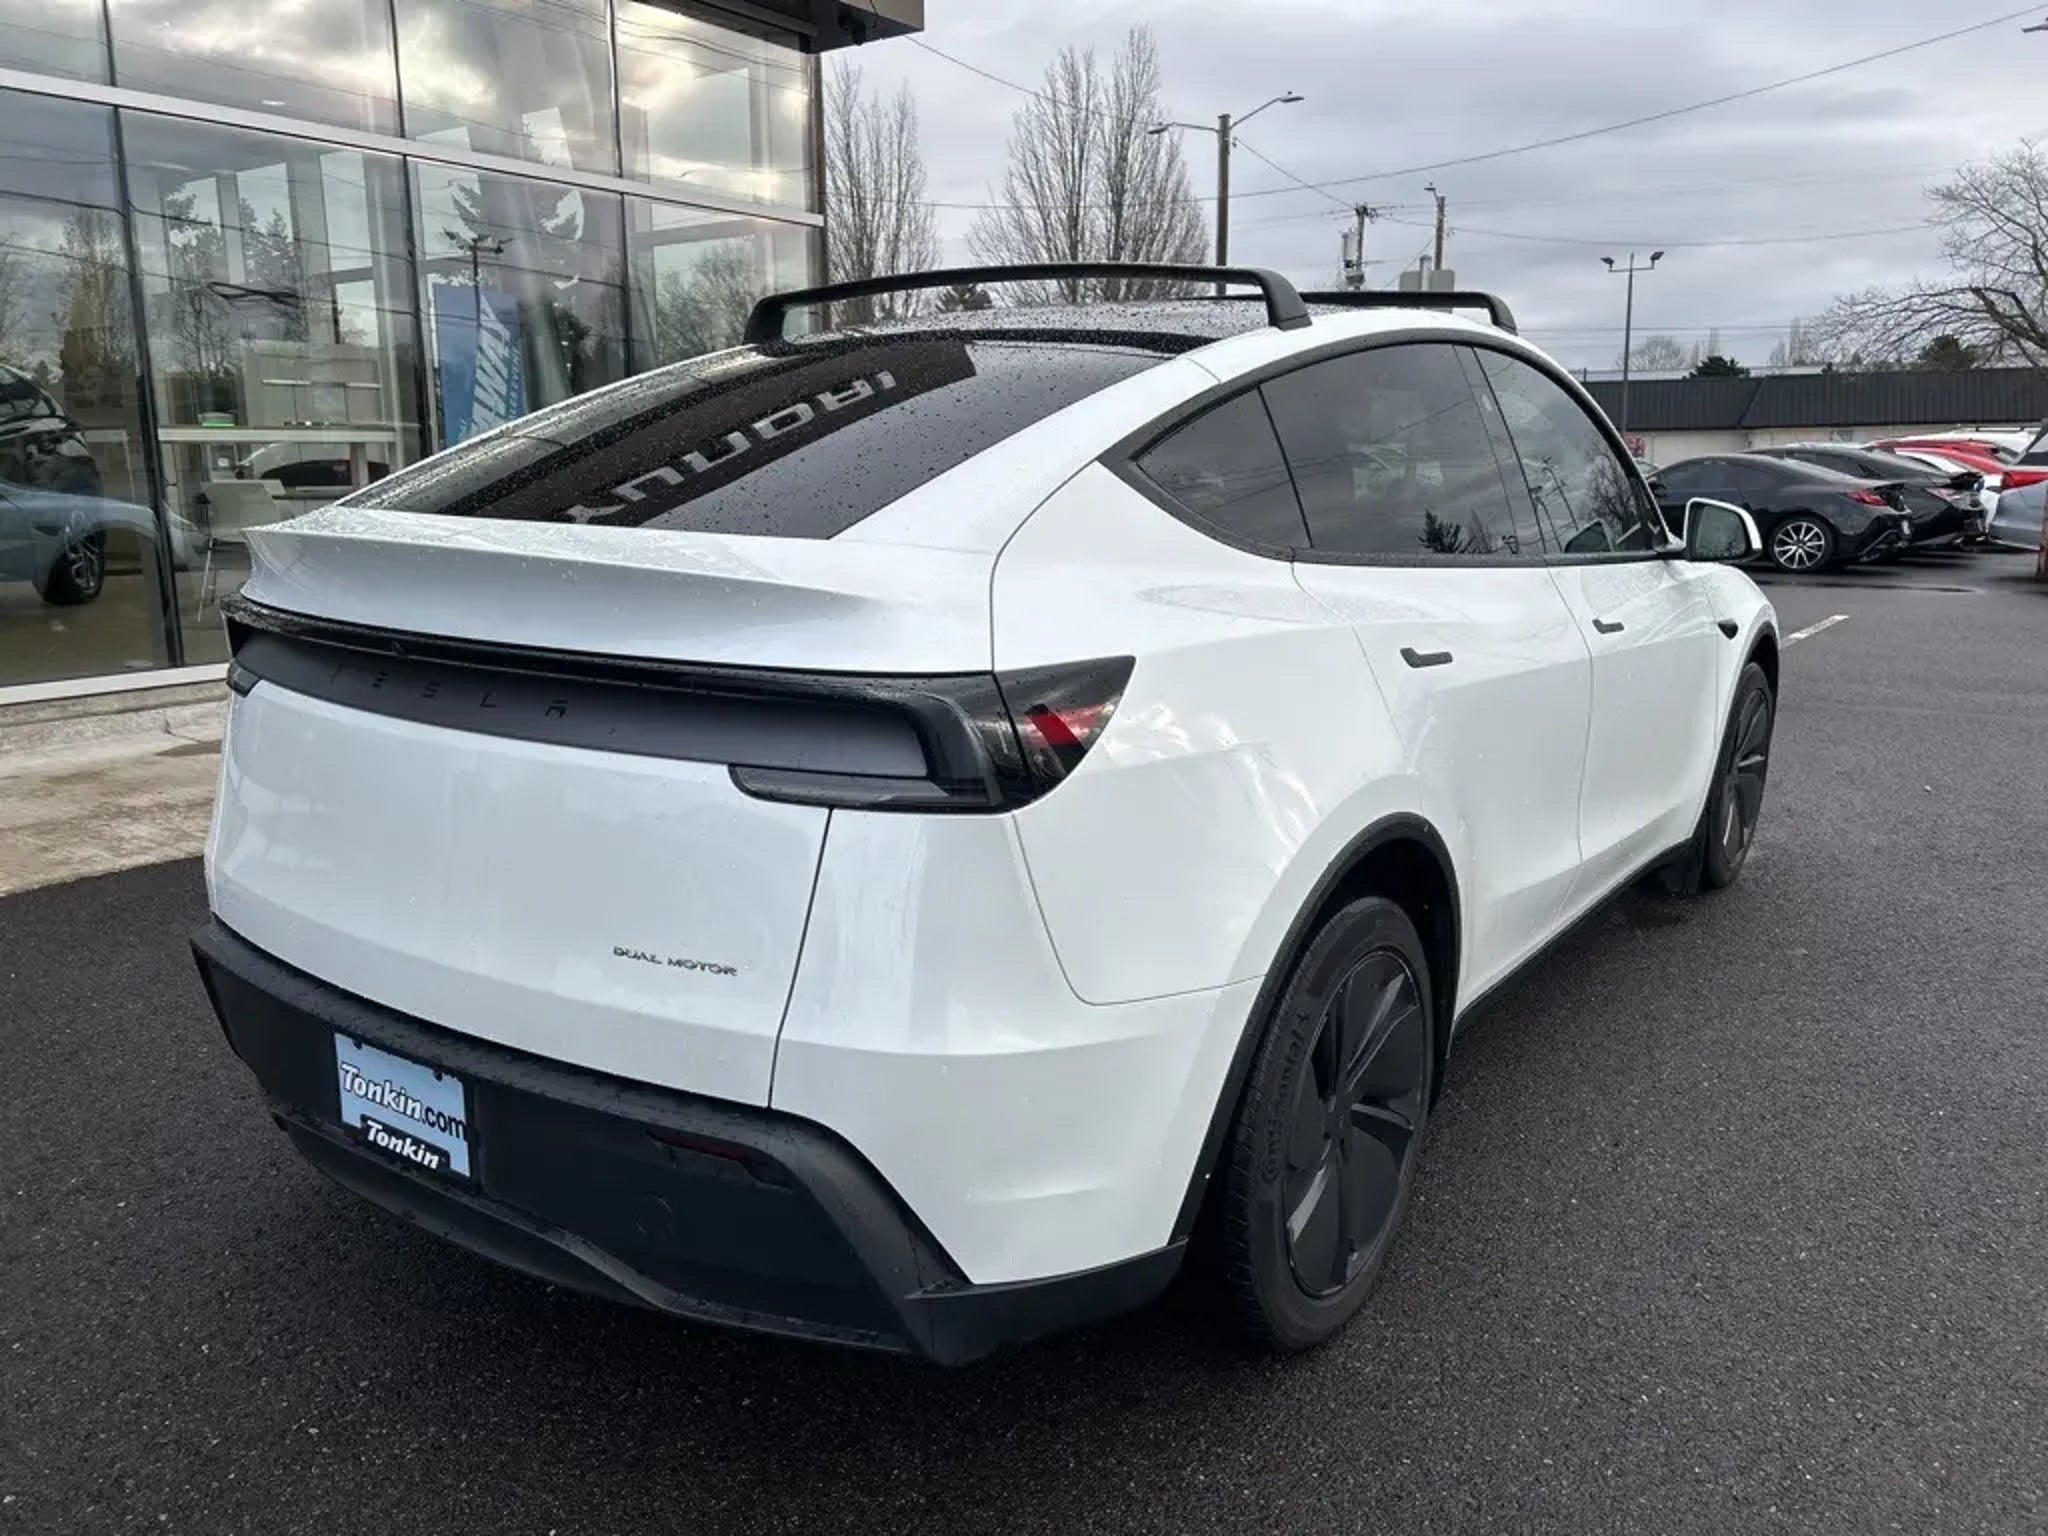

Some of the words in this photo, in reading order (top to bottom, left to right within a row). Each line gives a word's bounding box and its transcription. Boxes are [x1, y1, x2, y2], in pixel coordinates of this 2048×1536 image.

[471, 293, 511, 434] AWAY
[326, 662, 569, 720] TESLA
[613, 945, 662, 966] DUAL
[667, 957, 738, 977] MOTOR
[340, 1061, 468, 1143] Tonkin.com
[366, 1119, 440, 1170] Tonkin
